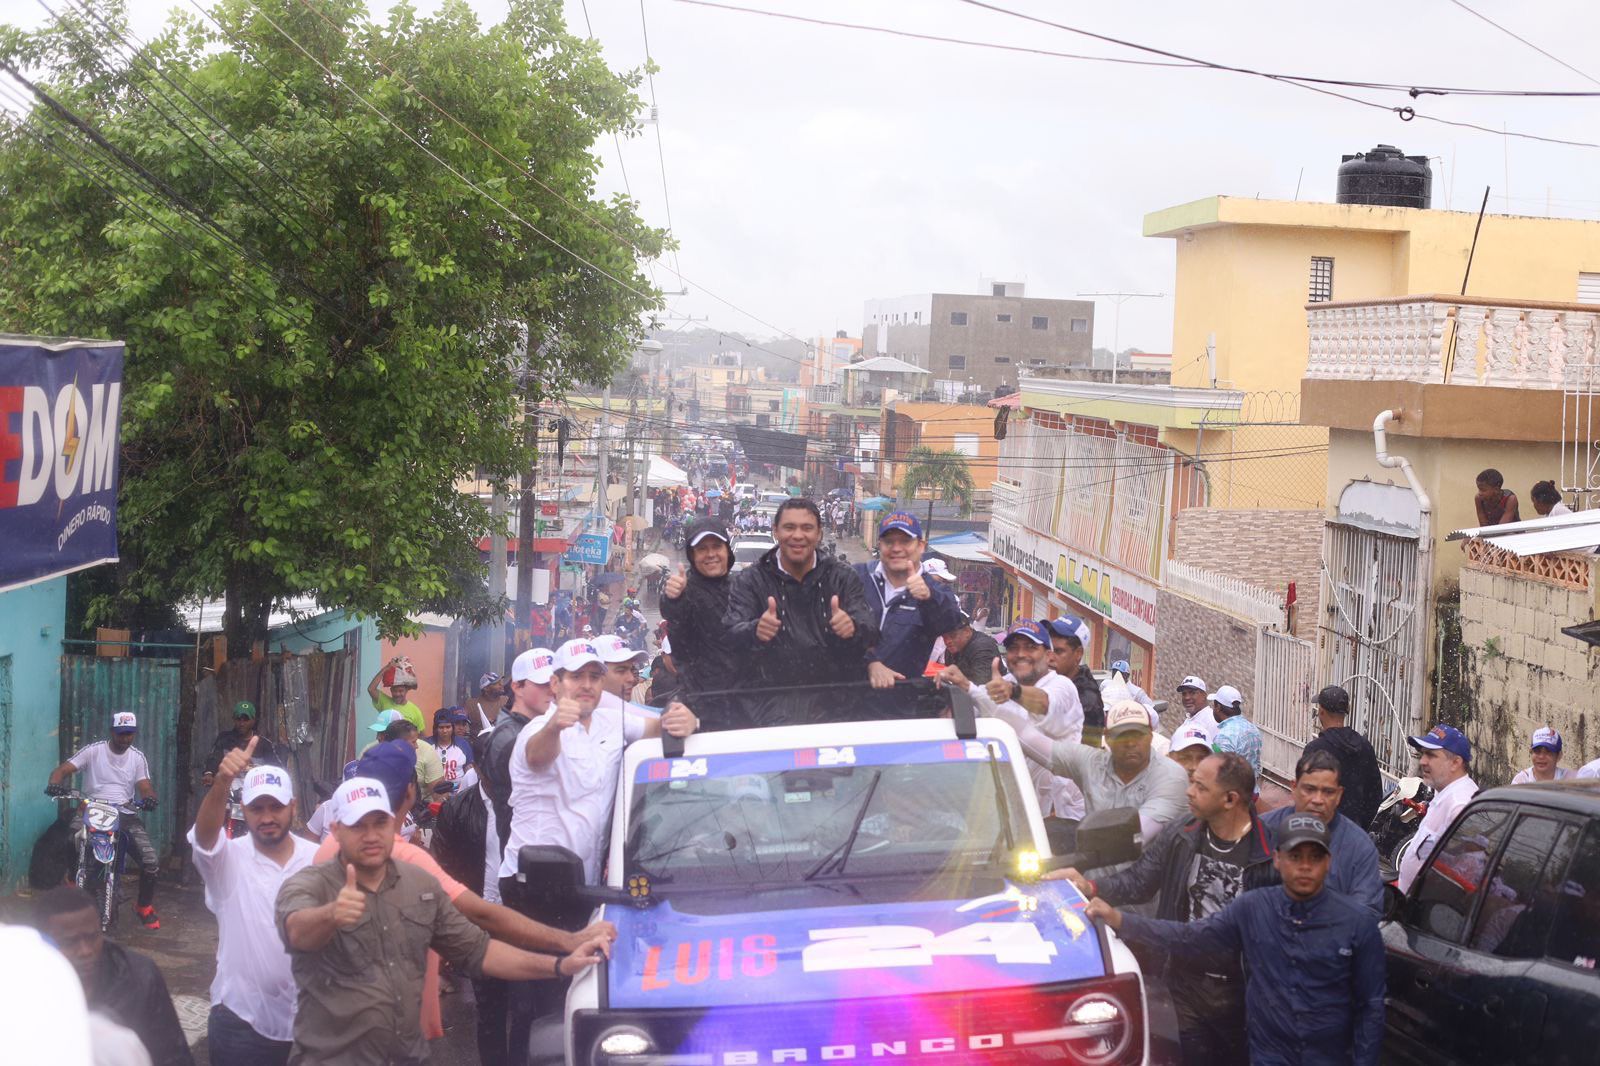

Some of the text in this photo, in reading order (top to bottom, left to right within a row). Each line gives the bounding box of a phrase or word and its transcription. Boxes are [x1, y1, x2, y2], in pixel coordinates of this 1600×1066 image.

[57, 501, 111, 551] DINERO RÁPIDO
[992, 530, 1004, 556] Auto
[1005, 535, 1054, 583] Motoprestamos
[1055, 554, 1112, 618] ALMA
[818, 746, 856, 765] 24
[670, 758, 708, 778] 24
[250, 773, 281, 789] LUIS 24
[346, 786, 381, 803] LUIS 24
[88, 808, 117, 826] 27
[641, 922, 1058, 991] LUIS 24
[723, 1033, 1004, 1066] BRONCO
